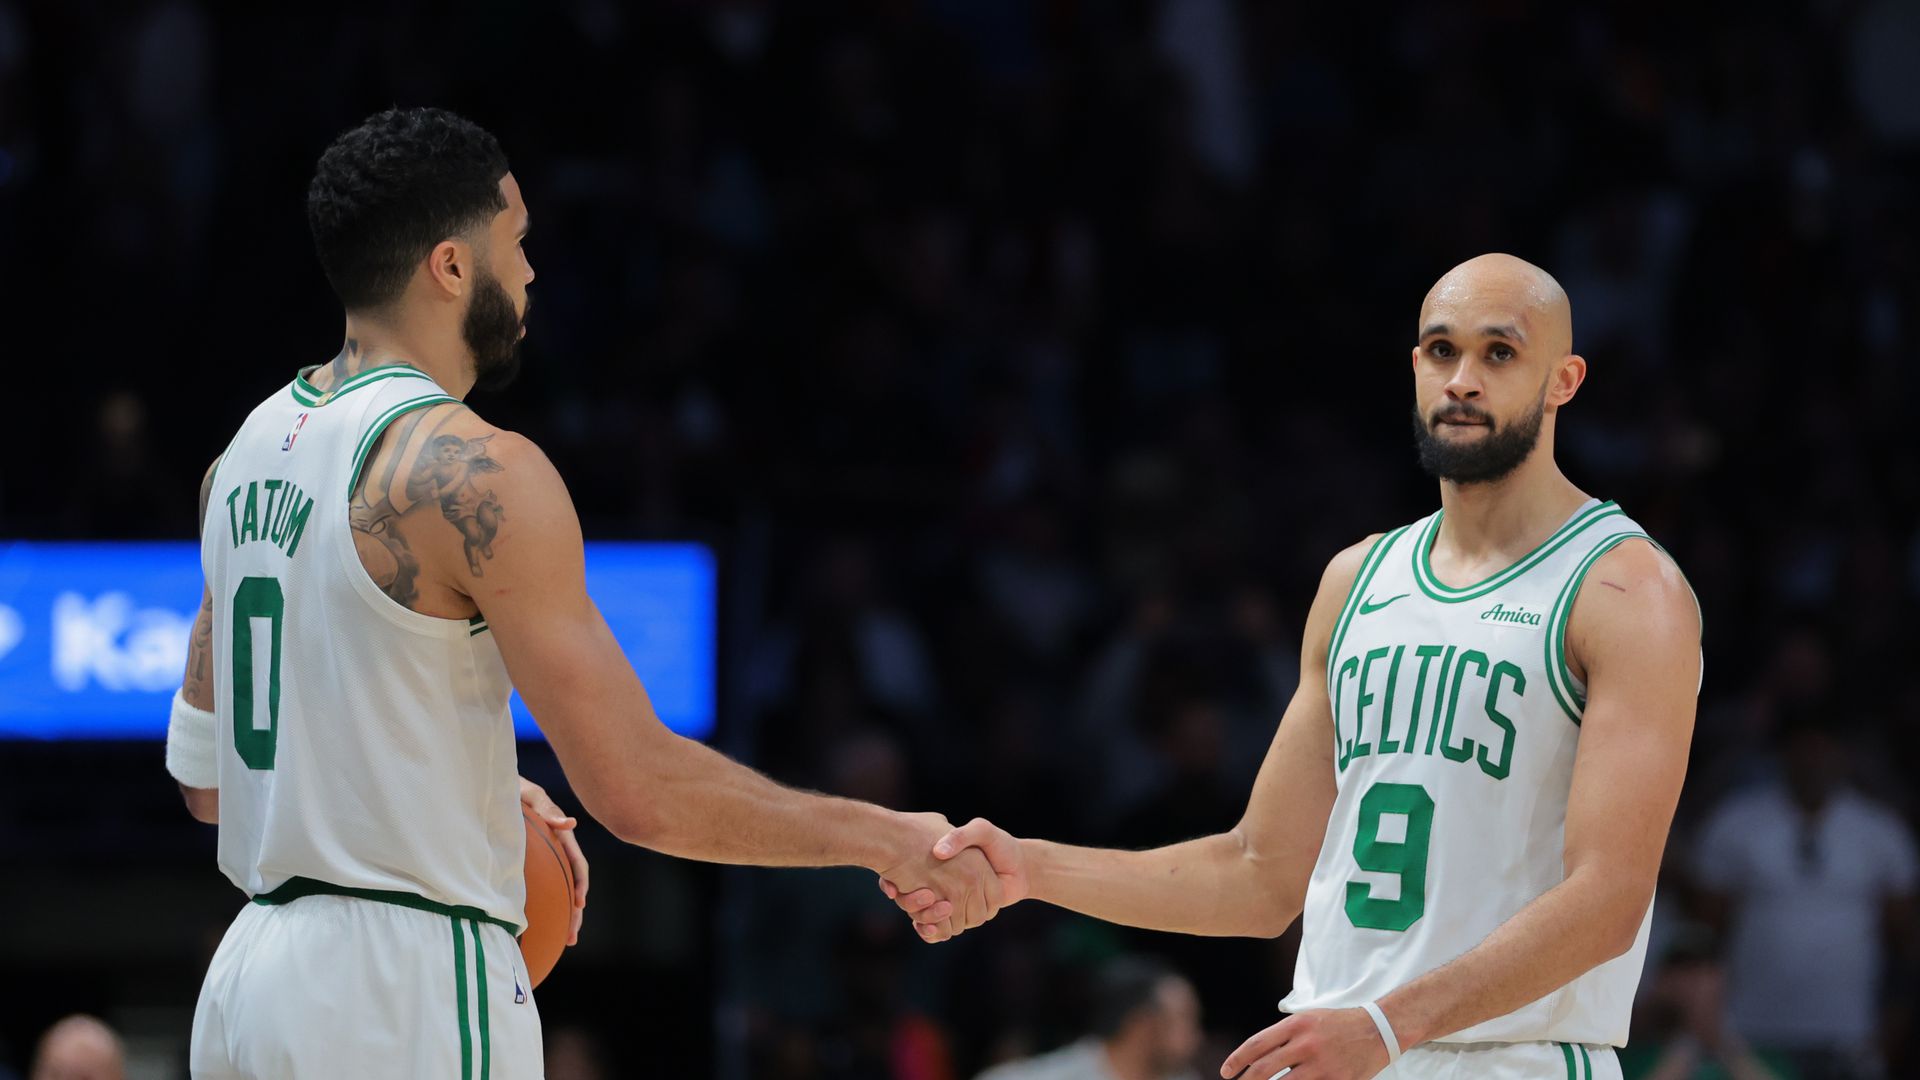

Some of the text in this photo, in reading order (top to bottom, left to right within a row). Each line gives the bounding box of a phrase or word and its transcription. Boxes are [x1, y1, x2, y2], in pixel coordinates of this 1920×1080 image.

[226, 479, 314, 558] TATUM
[233, 576, 284, 771] 0
[1480, 603, 1542, 626] Amica
[1335, 644, 1527, 781] CELTICS
[1345, 782, 1434, 932] 9
